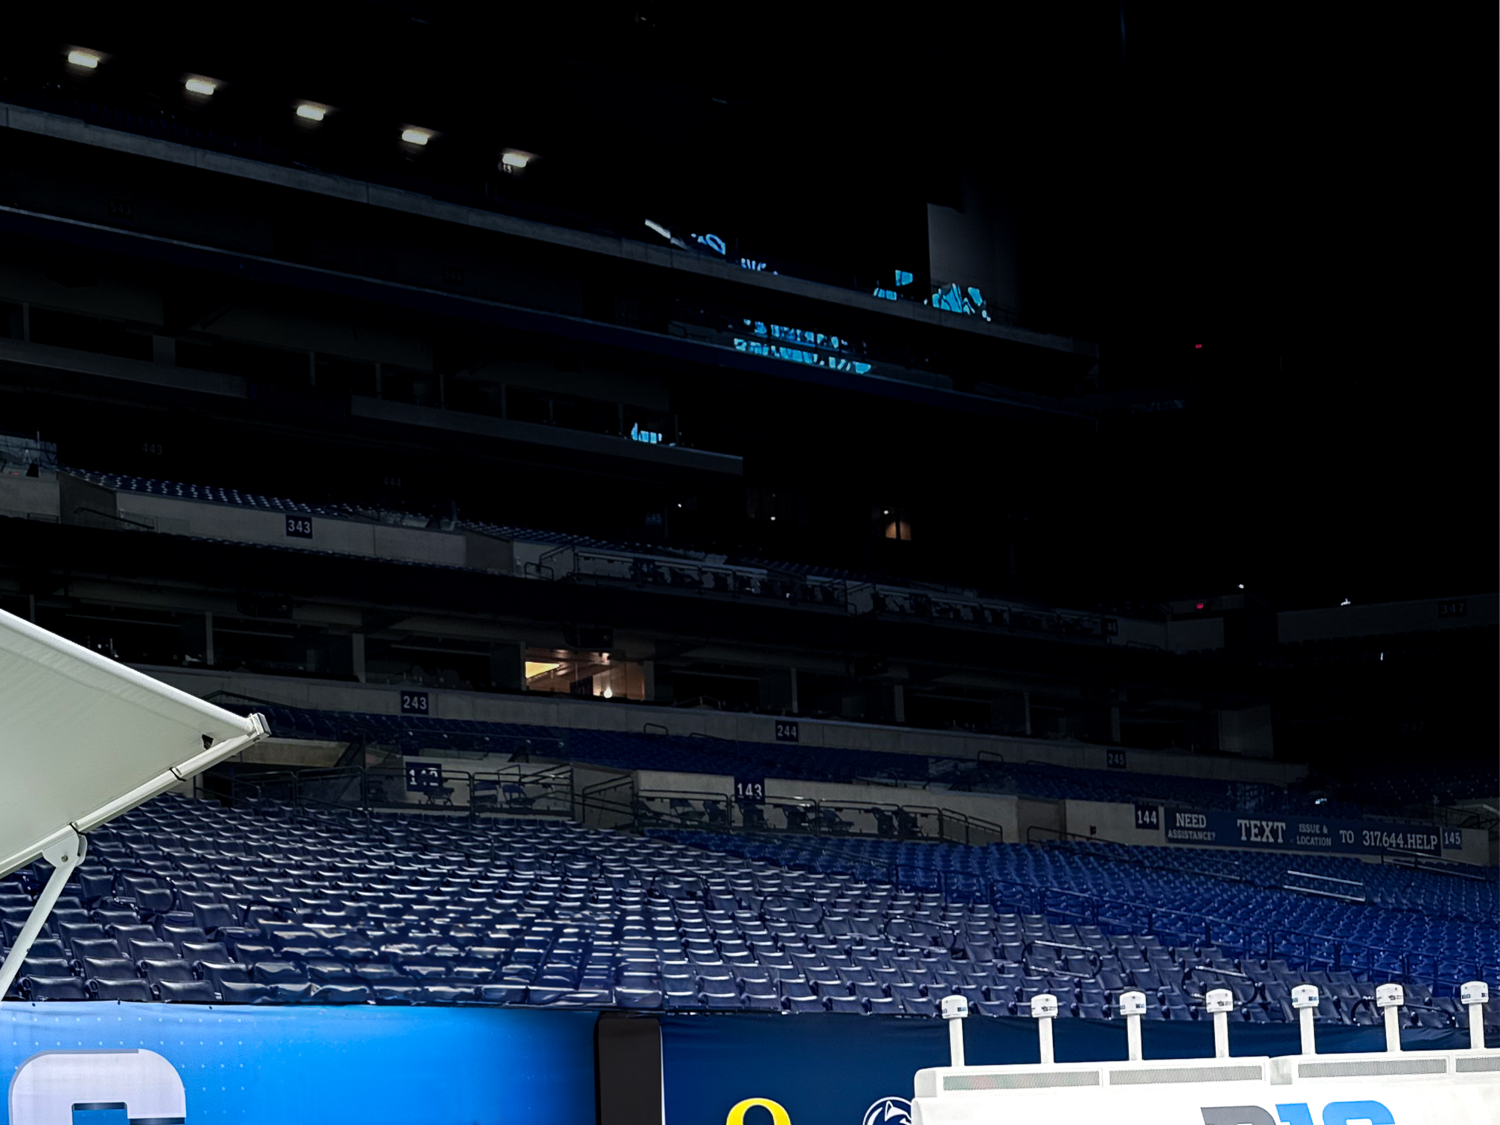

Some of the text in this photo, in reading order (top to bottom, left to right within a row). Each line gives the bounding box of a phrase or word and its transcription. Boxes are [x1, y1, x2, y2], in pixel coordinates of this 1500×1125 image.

[287, 518, 312, 535] 343
[402, 694, 428, 711] 243
[776, 724, 798, 739] 244
[736, 782, 763, 800] 143
[1137, 810, 1158, 825] 144
[1175, 812, 1207, 829] NEED
[1167, 829, 1216, 842] ASSISTANCE?
[1236, 818, 1286, 844] TEXT
[1298, 823, 1321, 834] ISSUE
[1295, 835, 1332, 847] LOCATION
[1339, 829, 1355, 844] TO
[1443, 831, 1462, 846] 145
